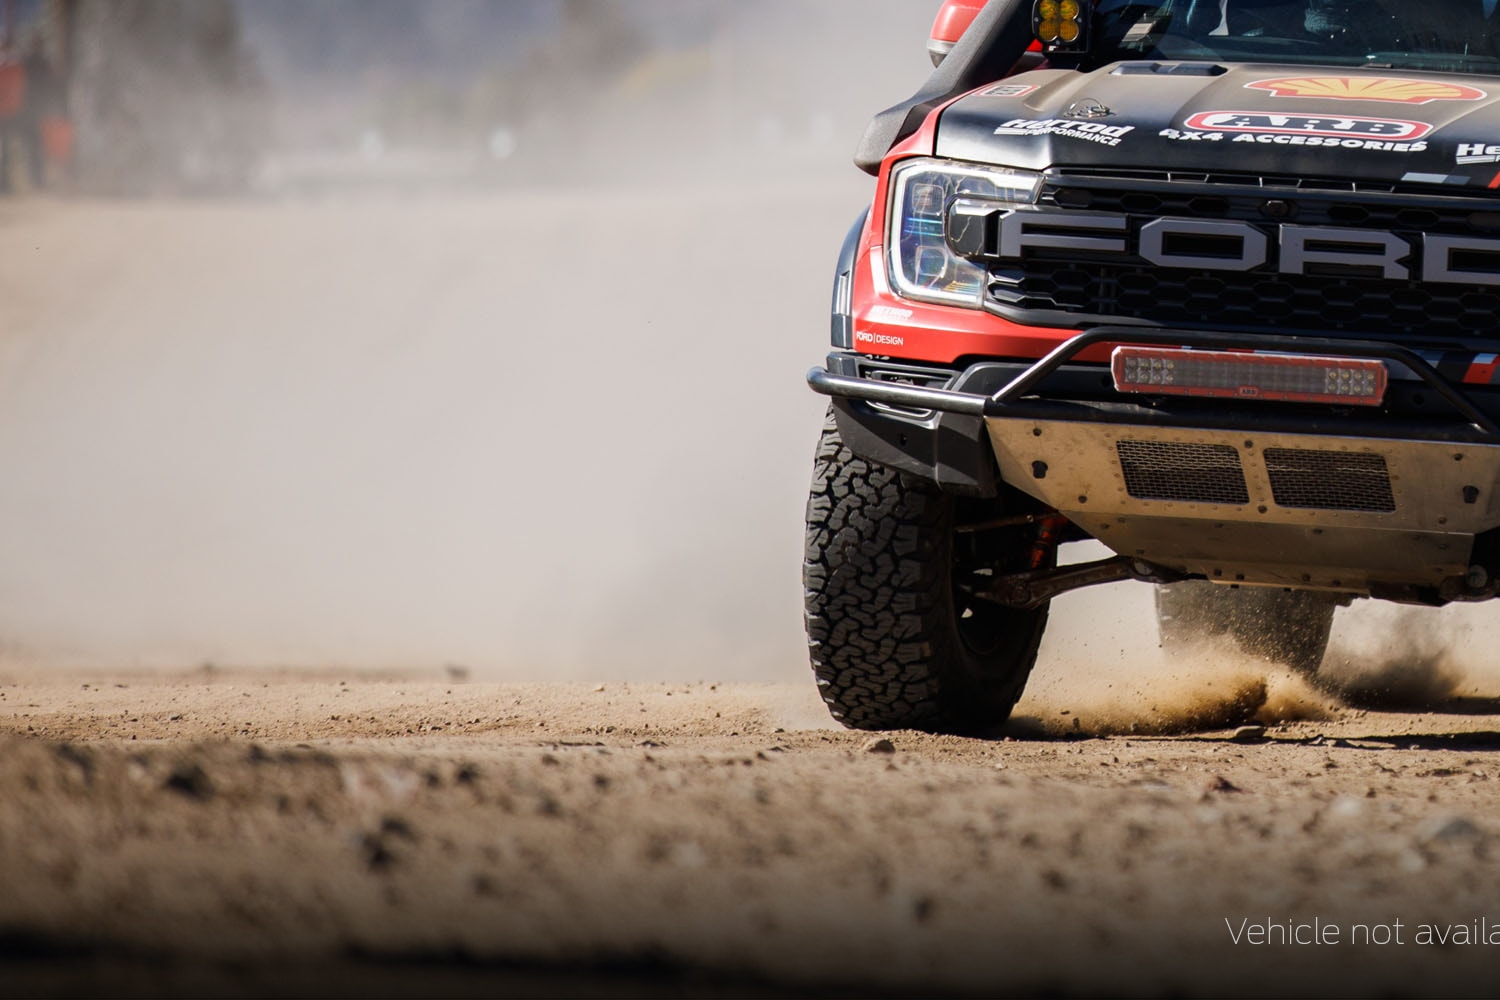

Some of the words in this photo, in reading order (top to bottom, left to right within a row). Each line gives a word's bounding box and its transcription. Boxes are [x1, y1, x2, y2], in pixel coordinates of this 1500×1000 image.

[1001, 118, 1135, 138] Herrod
[1213, 115, 1404, 135] ARB
[1025, 127, 1122, 147] PERFORMANCE
[1232, 133, 1428, 152] ACCESSORIES
[856, 331, 873, 343] FORD
[875, 334, 904, 346] DESIGN
